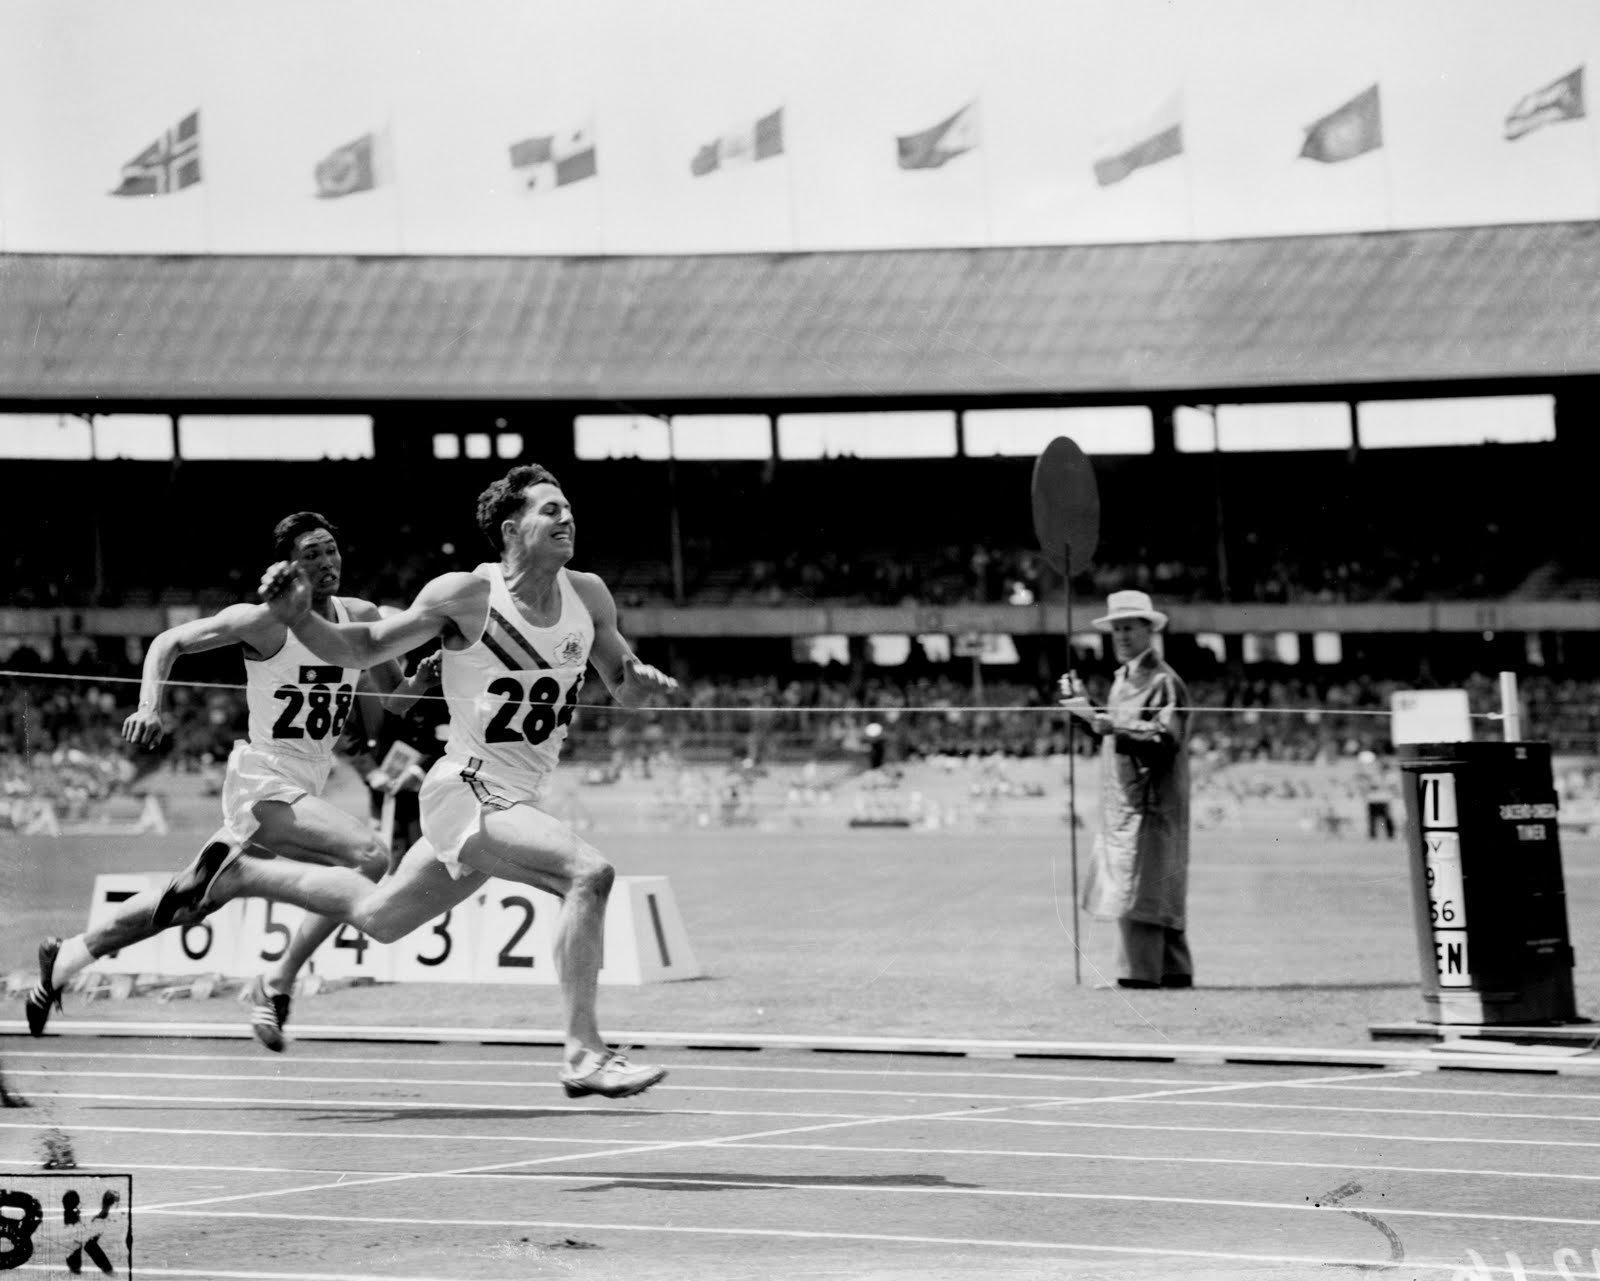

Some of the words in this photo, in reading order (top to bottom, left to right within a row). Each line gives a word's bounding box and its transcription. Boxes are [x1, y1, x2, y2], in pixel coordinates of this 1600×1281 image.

[272, 683, 352, 740] 288
[260, 900, 291, 962] 5
[334, 922, 369, 965] 4
[416, 908, 453, 967] 3
[498, 895, 535, 968] 2
